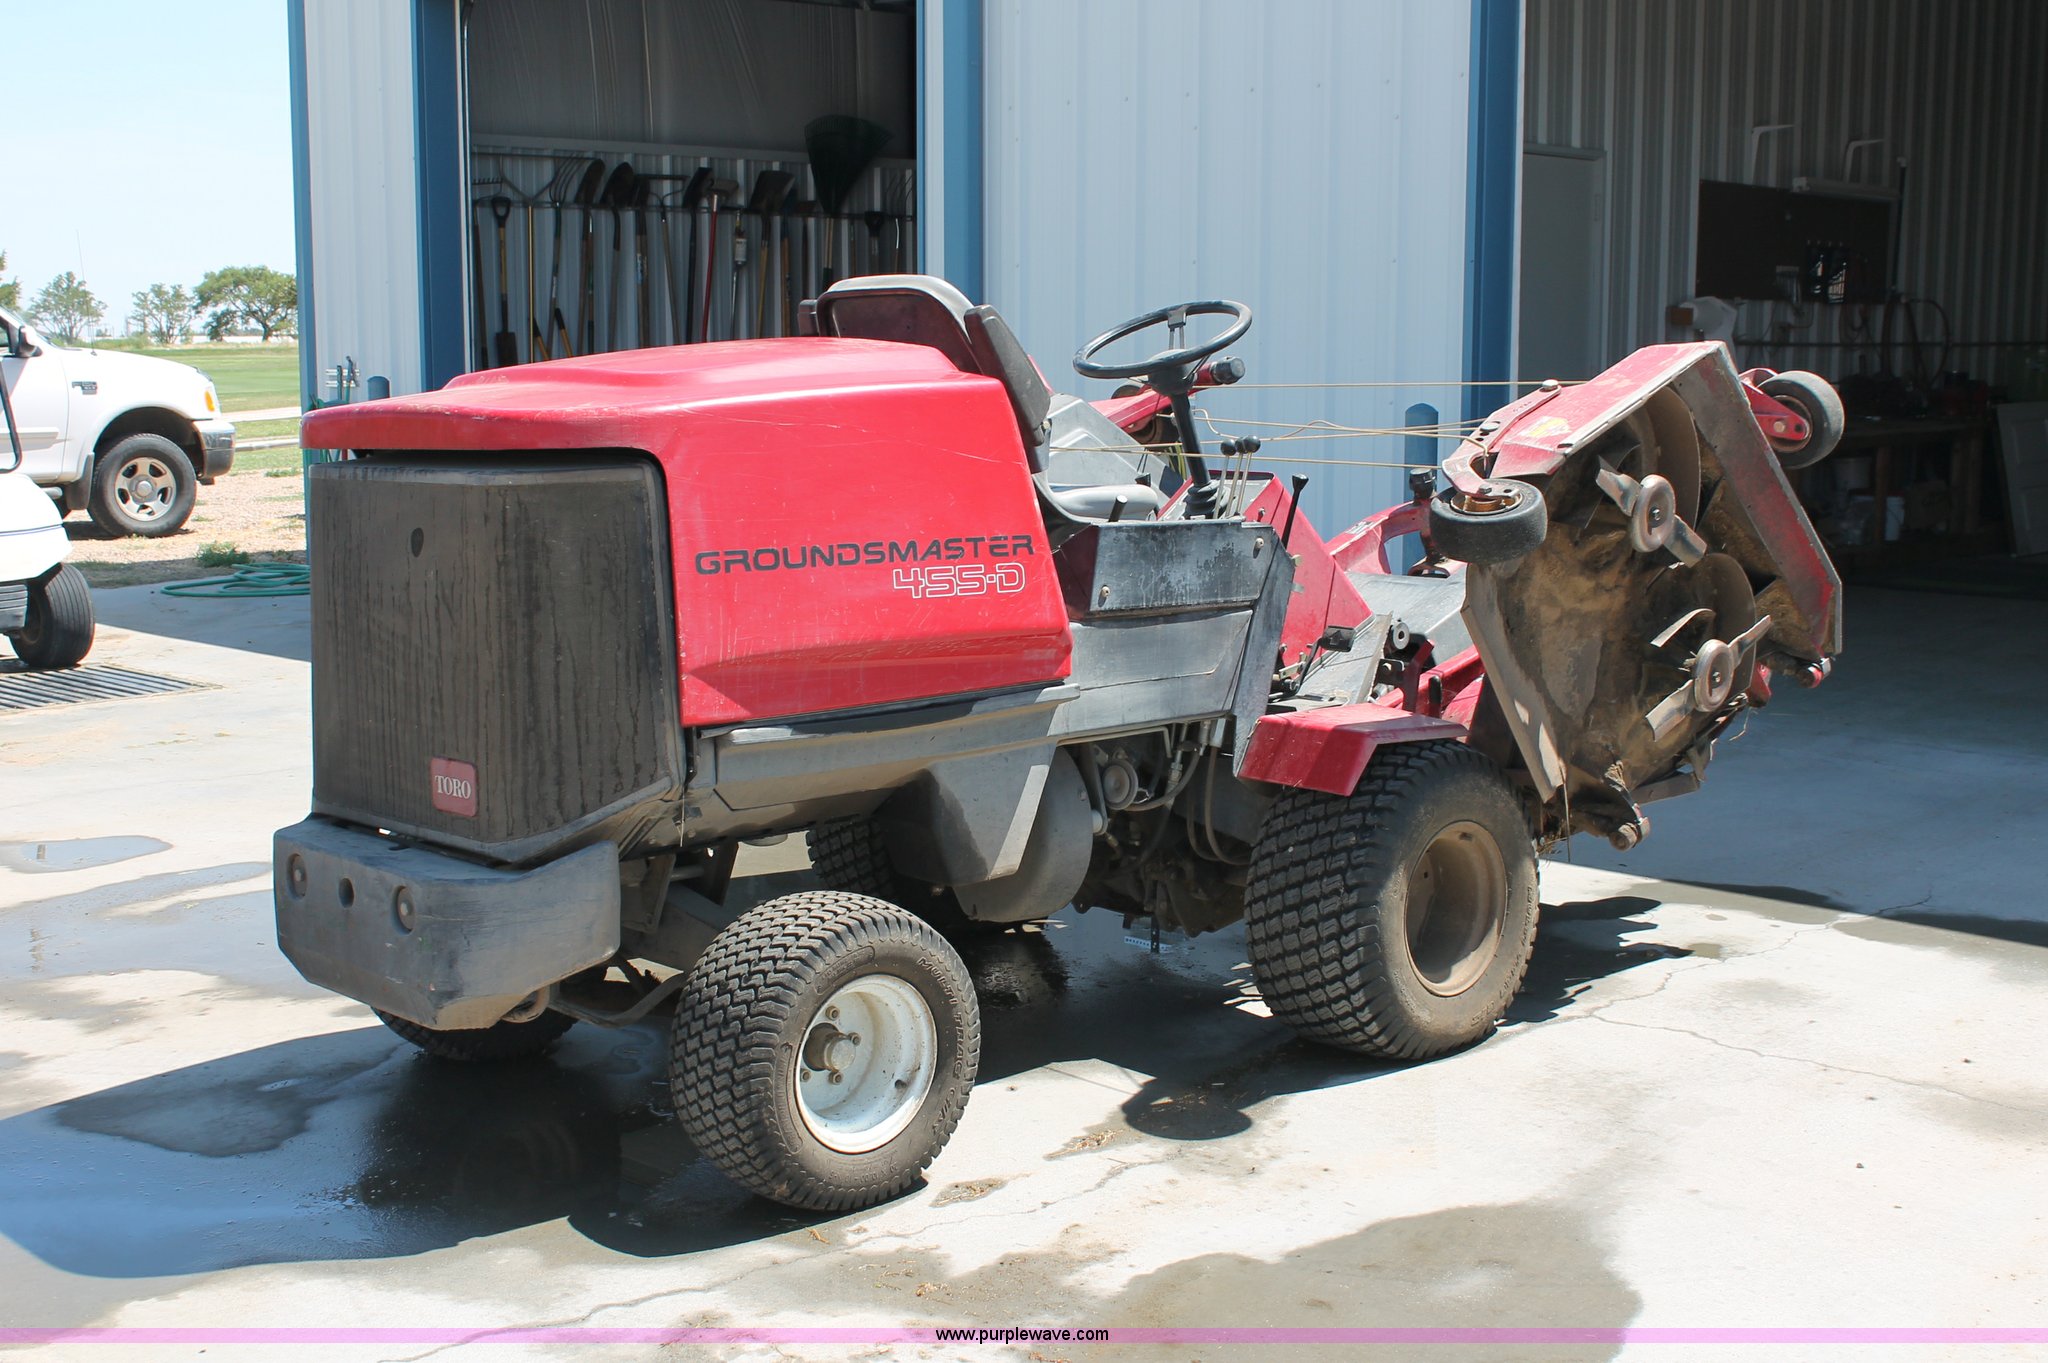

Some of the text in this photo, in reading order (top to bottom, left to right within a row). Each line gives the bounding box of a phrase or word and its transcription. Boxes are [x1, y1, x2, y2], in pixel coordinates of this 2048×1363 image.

[695, 535, 1034, 575] GROUNDSMASTER
[434, 775, 472, 799] TORO
[916, 956, 960, 1005] MULTI
[952, 1011, 965, 1079] TRAC
